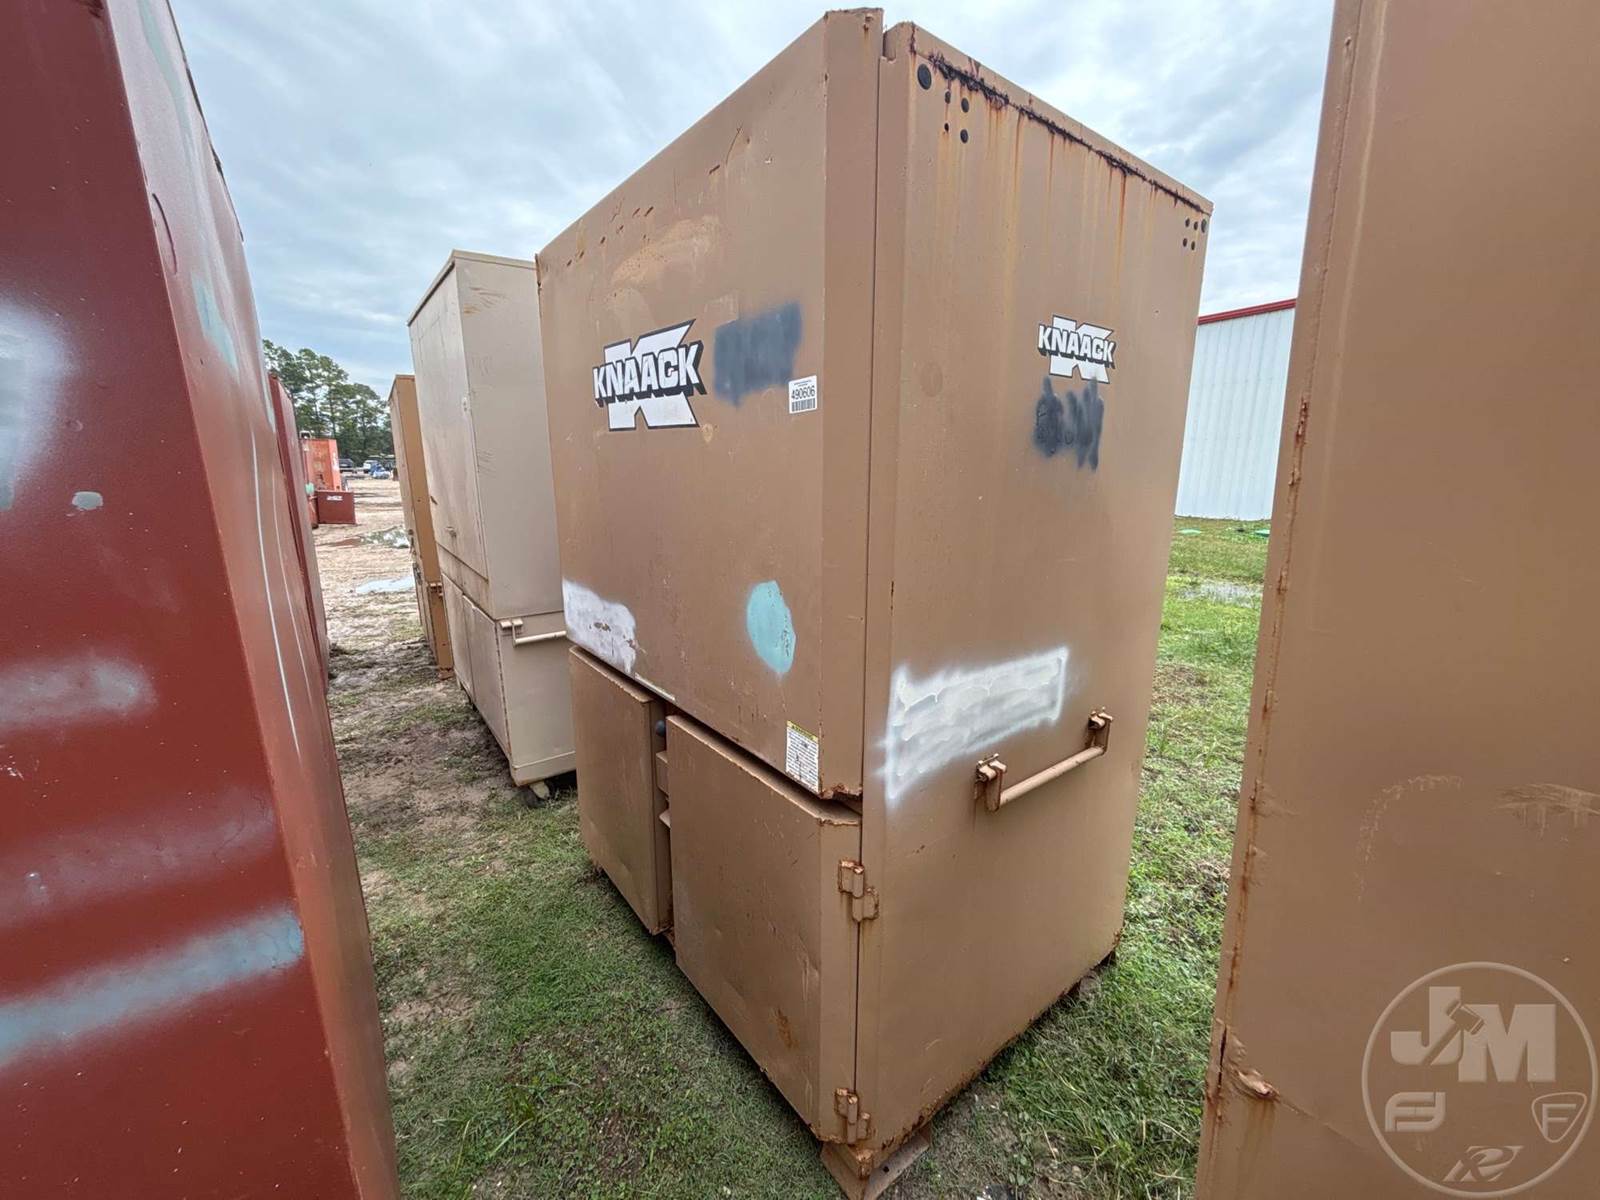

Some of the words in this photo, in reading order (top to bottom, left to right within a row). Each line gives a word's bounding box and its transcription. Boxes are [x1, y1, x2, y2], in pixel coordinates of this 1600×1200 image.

[1038, 324, 1116, 368] KNAACK
[593, 341, 705, 404] KNAACK
[791, 385, 815, 400] 490606
